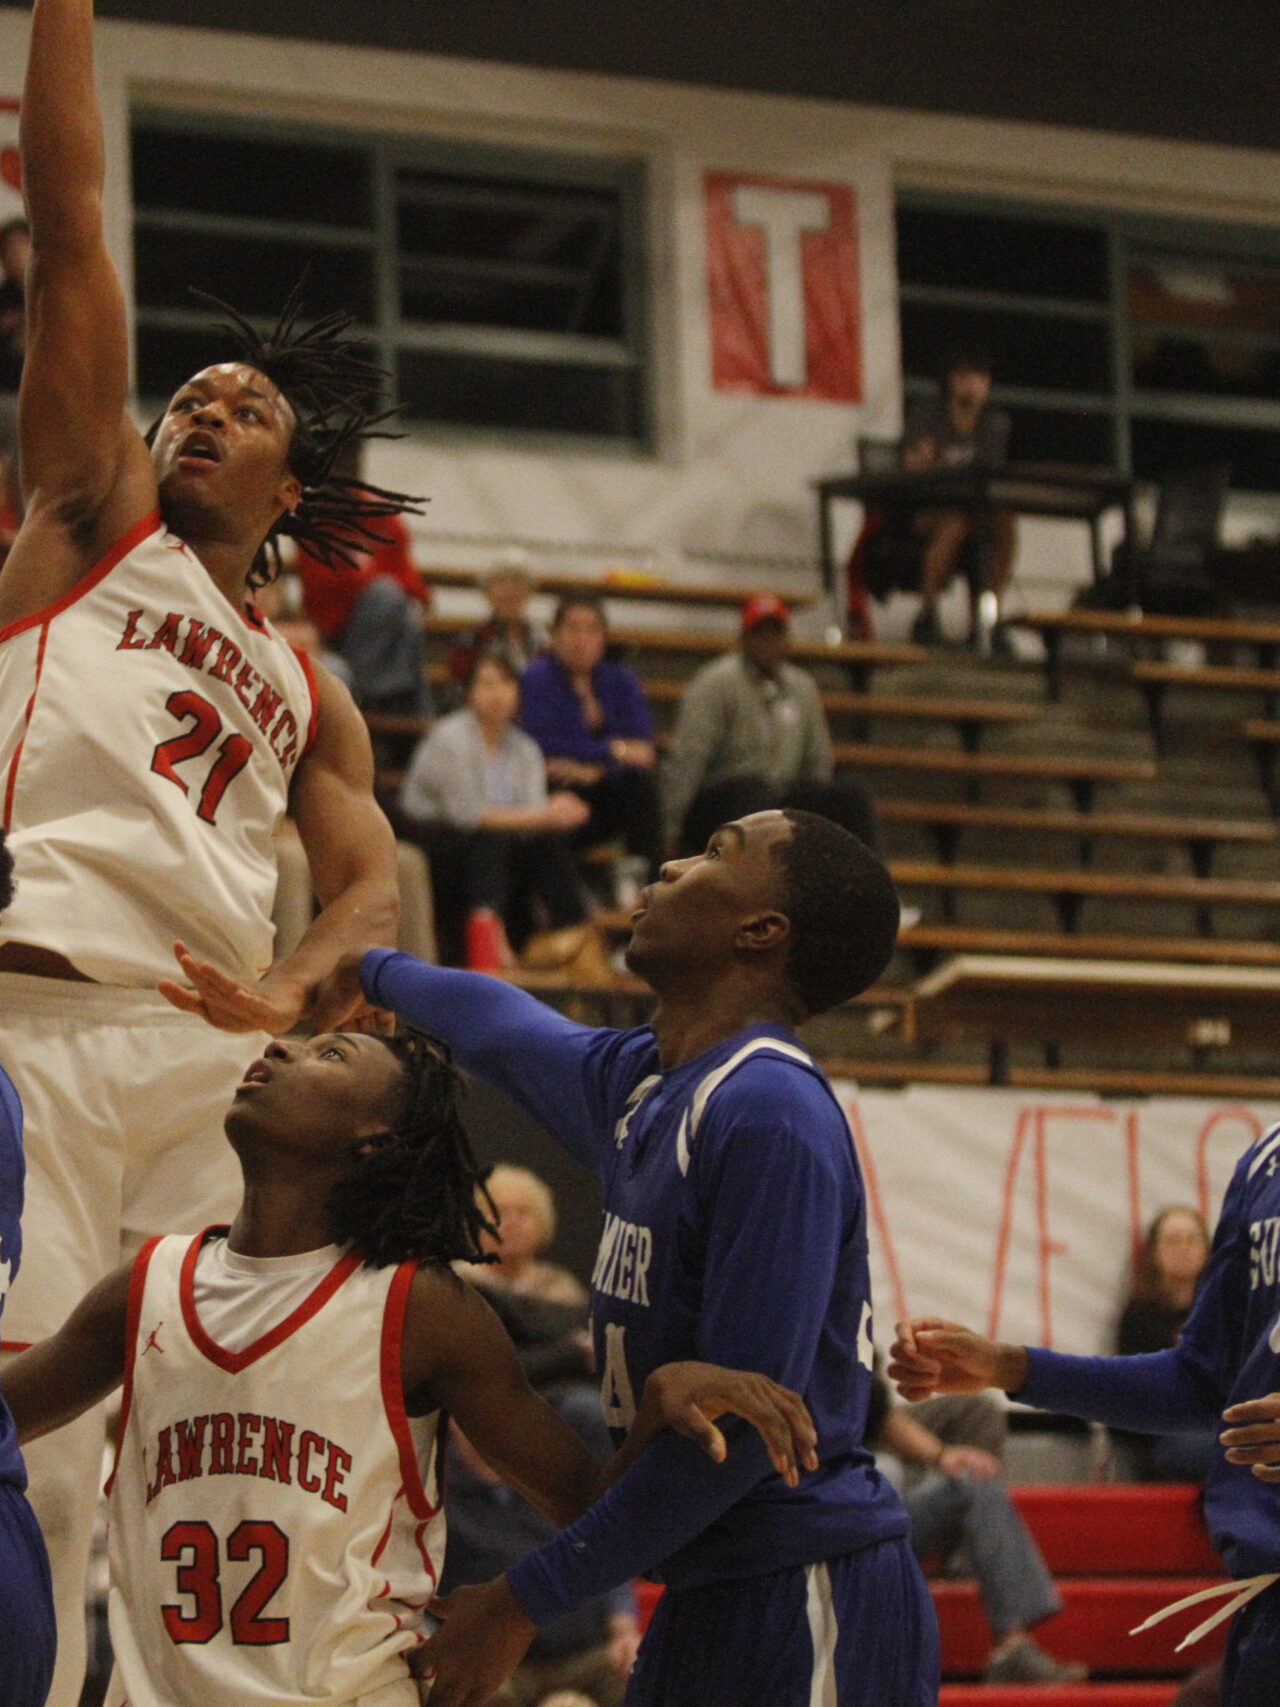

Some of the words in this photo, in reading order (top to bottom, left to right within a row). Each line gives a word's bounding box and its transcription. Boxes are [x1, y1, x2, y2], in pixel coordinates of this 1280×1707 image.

[728, 185, 831, 389] T
[116, 609, 298, 769] LAWRENC
[150, 690, 254, 826] 21
[160, 1520, 290, 1646] 32
